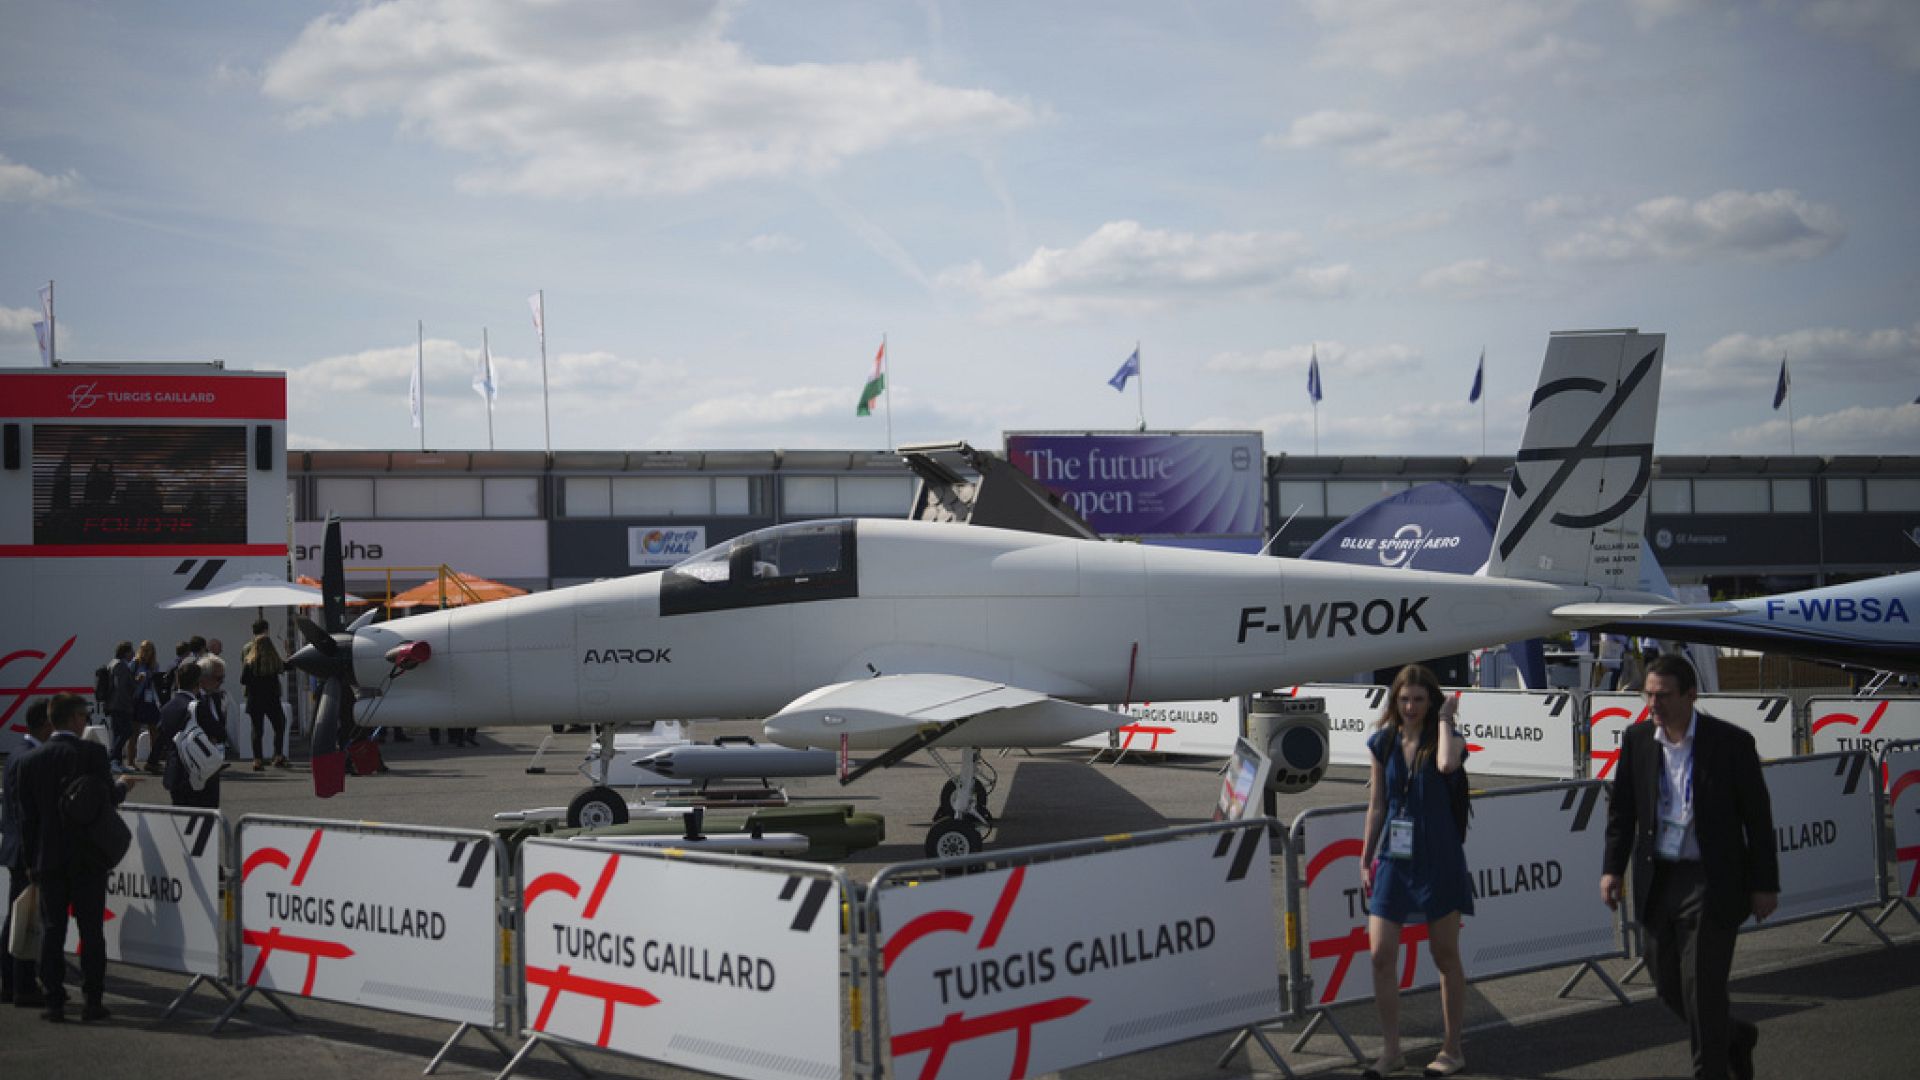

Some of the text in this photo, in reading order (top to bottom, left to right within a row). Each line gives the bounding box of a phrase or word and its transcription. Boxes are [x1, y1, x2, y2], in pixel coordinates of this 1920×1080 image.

[107, 392, 215, 403] TURGIS GAILLARD
[1025, 447, 1175, 480] The future
[1061, 489, 1133, 520] open
[1340, 536, 1460, 550] BLUE SPIRIT AERO
[1237, 596, 1430, 643] F-WROK
[1767, 597, 1909, 624] F-WBSA
[583, 647, 671, 664] AAROK
[1132, 708, 1219, 724] TURGIS GAILLARD
[1475, 723, 1544, 743] GAILLARD
[105, 869, 183, 903] GAILLARD
[266, 891, 447, 941] TURGIS GAILLARD
[553, 922, 776, 992] TURGIS GAILLARD
[933, 915, 1216, 1004] TURGIS GAILLARD
